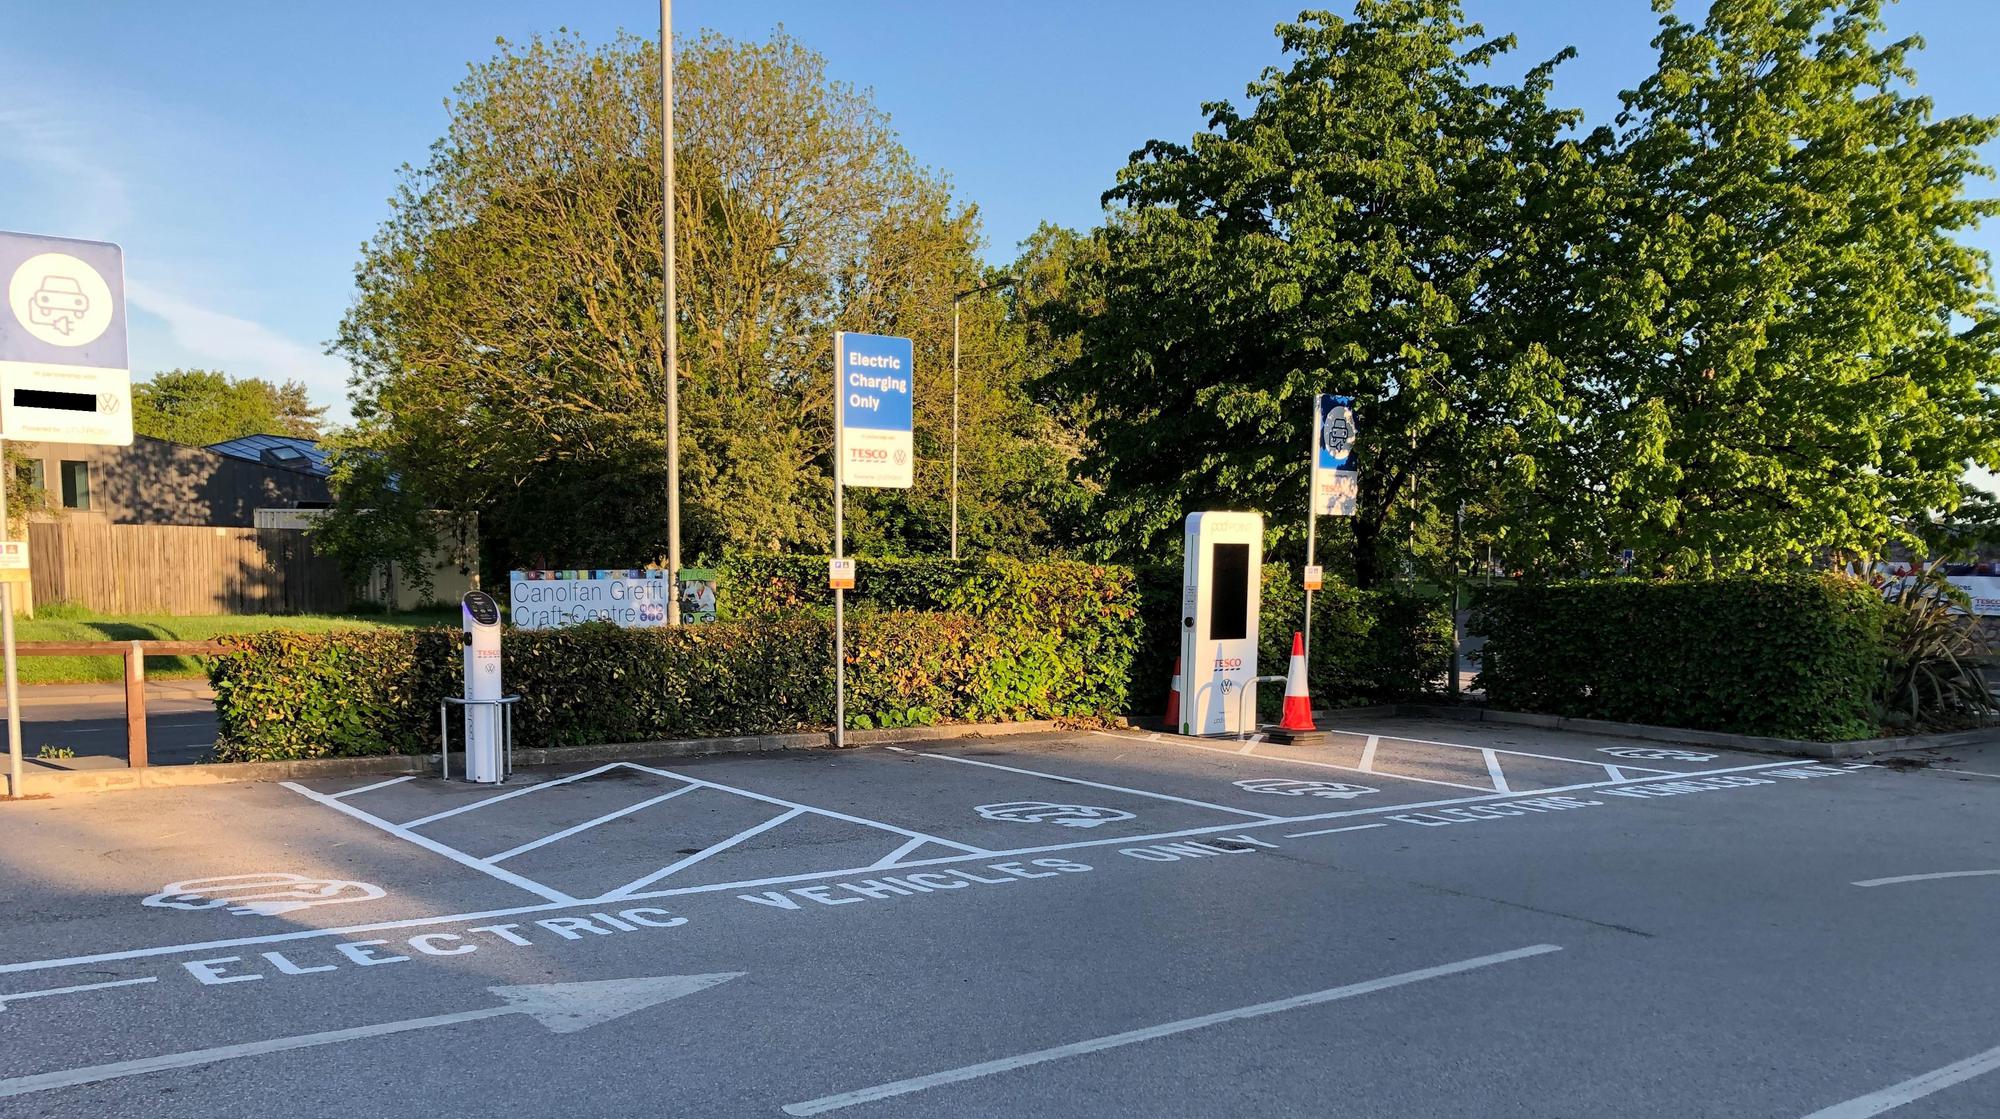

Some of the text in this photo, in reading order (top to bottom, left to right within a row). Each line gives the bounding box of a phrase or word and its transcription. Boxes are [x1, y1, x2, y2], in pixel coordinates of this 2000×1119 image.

[849, 352, 901, 369] Electric
[849, 373, 907, 394] Charging
[849, 394, 880, 412] Only
[850, 448, 888, 460] TESCO
[513, 580, 664, 603] Canolfan Grefft
[514, 604, 636, 627] Craft Centre
[1213, 658, 1242, 668] TESCO
[182, 834, 1280, 986] ELECTRIC VEHICLES ONLY
